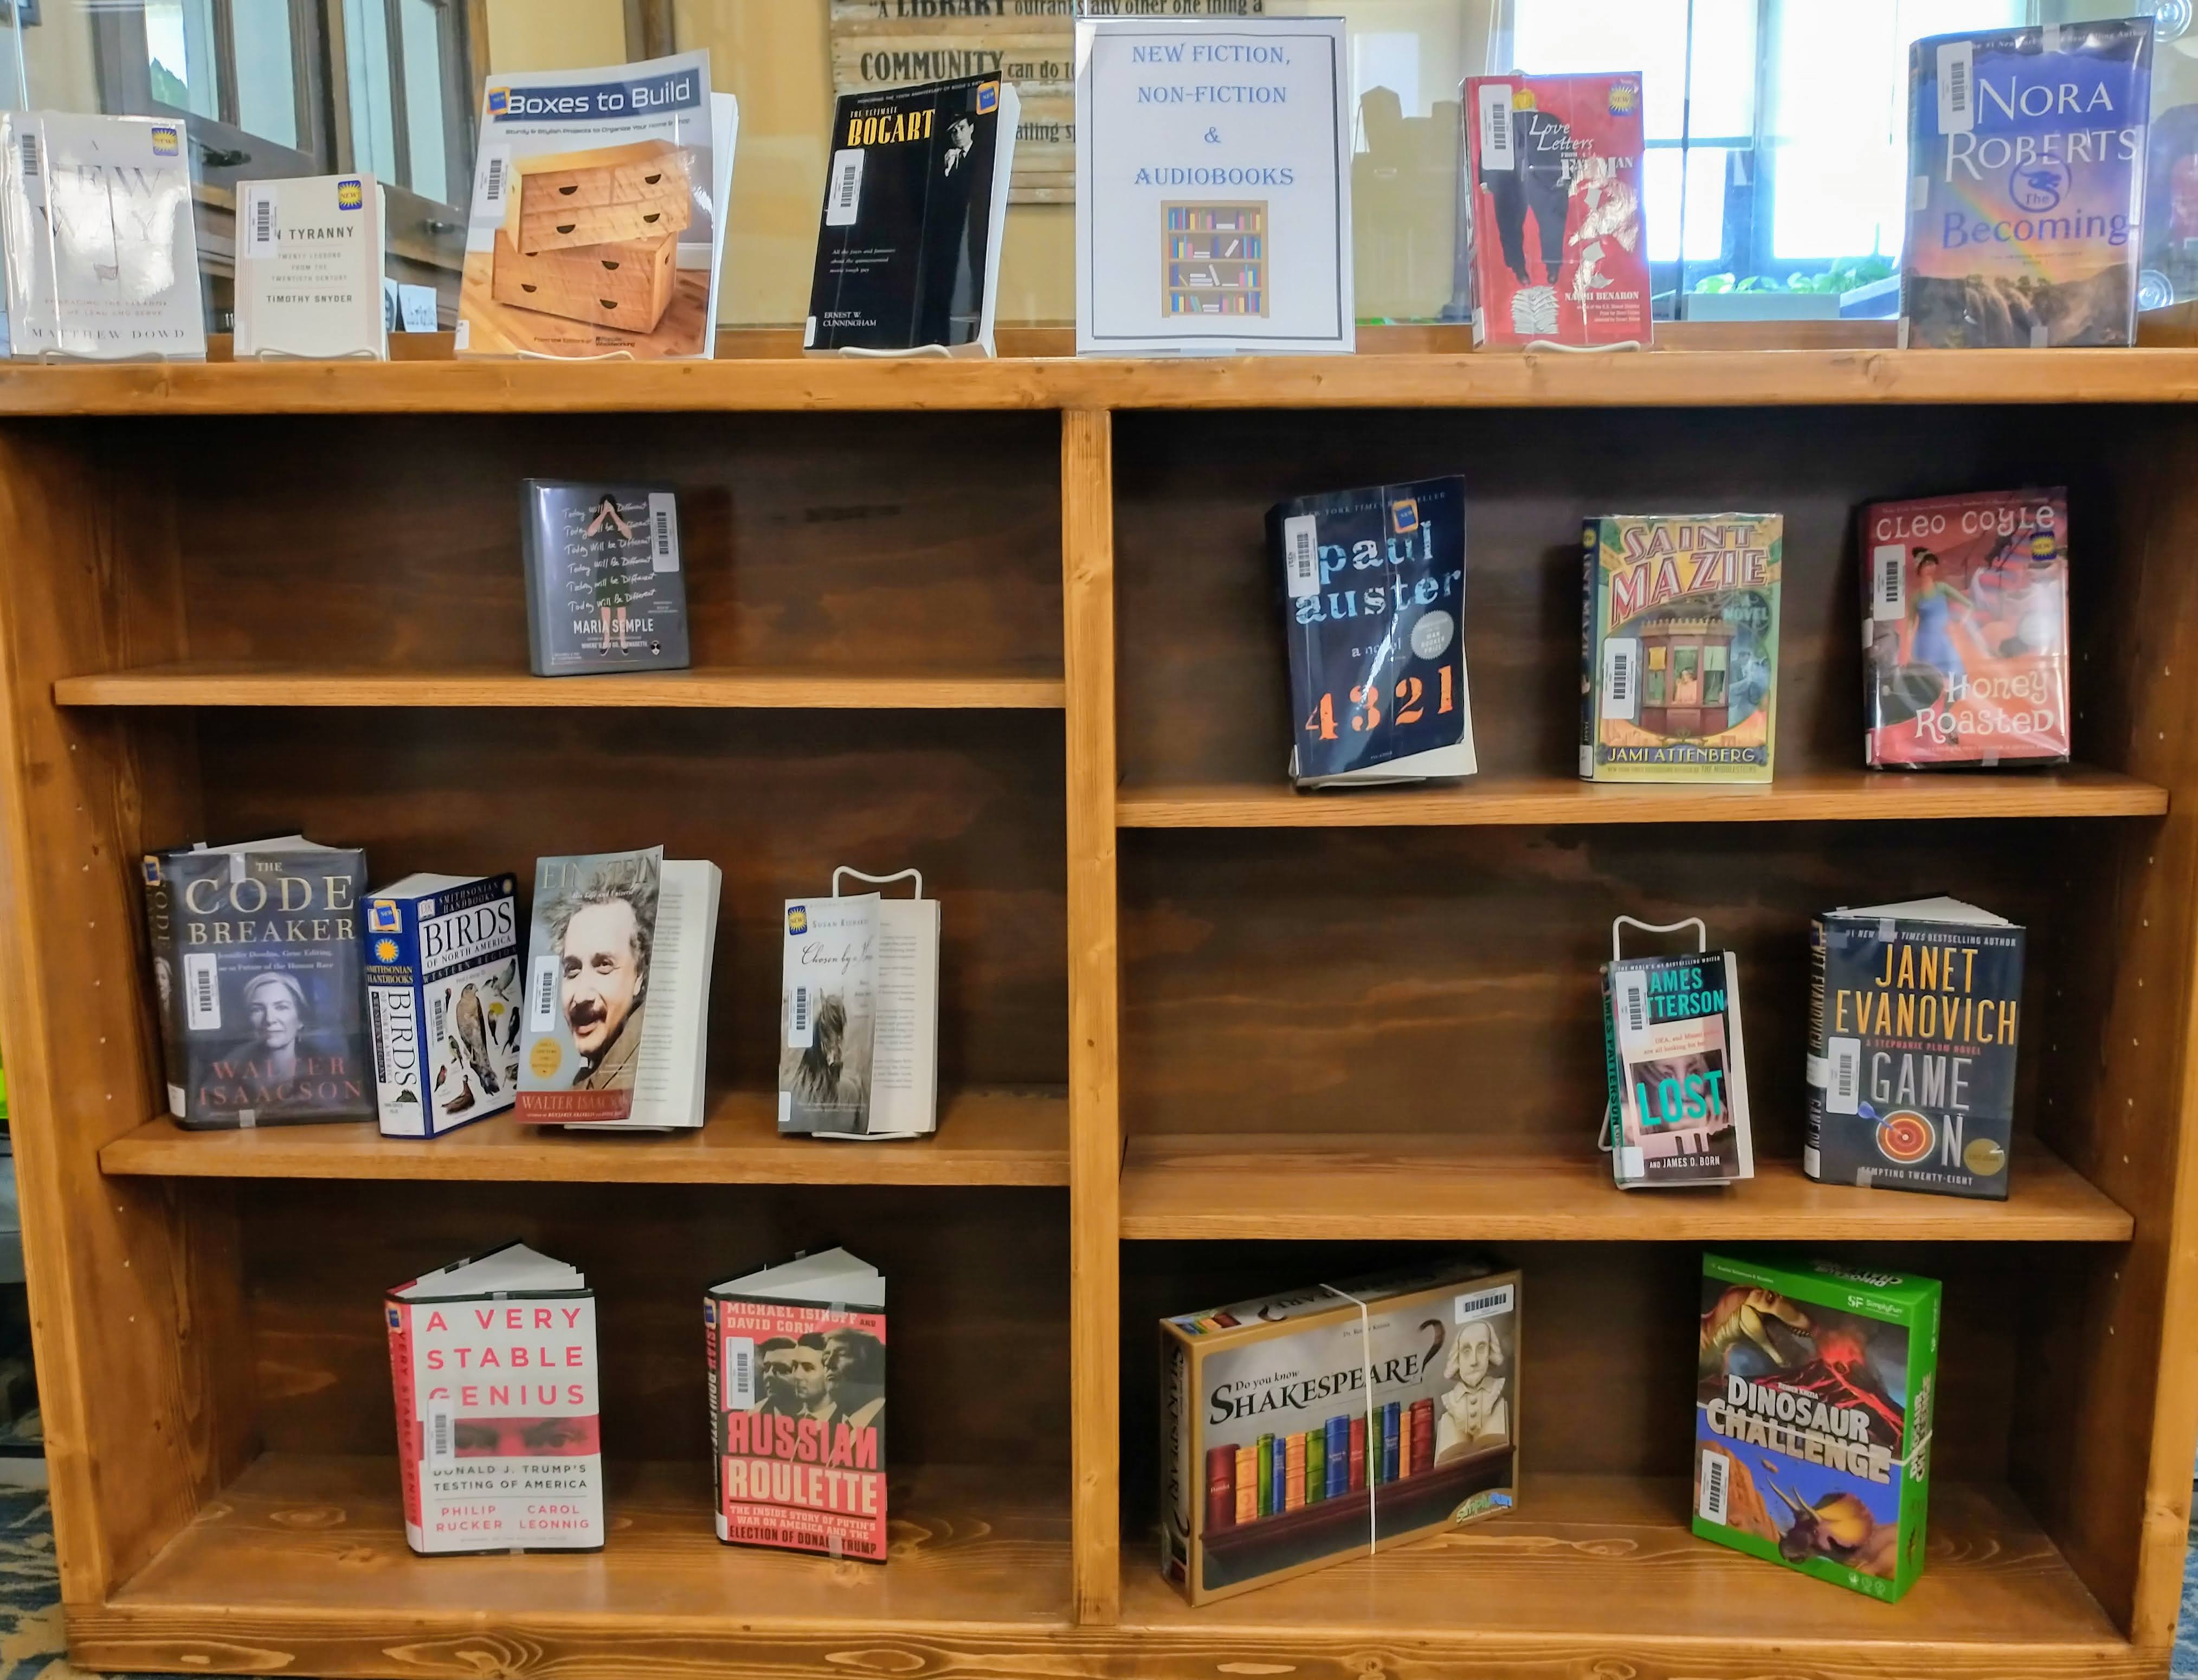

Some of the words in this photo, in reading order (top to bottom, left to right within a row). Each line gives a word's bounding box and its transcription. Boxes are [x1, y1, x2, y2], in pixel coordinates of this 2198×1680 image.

[897, 0, 1005, 17] LIBRARY
[1125, 0, 1165, 14] other
[1172, 0, 1202, 14] one
[1206, 0, 1246, 15] thing
[1253, 1, 1263, 14] a
[860, 50, 1005, 81] COMMUNITY
[1007, 61, 1034, 79] can
[1040, 60, 1059, 79] do
[1132, 42, 1185, 62] NEW
[1193, 44, 1291, 66] FICTION,
[507, 94, 590, 114] Boxes
[596, 92, 624, 111] to
[631, 77, 691, 108] Build
[1138, 86, 1286, 104] NON-FICTION
[1977, 76, 2114, 124] NORA
[601, 125, 631, 134] Organize
[847, 108, 936, 147] BOGART
[1204, 126, 1221, 144] &
[1529, 114, 1570, 136] Love
[1537, 133, 1595, 151] Letters
[1945, 128, 2137, 182] ROBERTS
[1134, 168, 1294, 185] AUDIOBOOKS
[2025, 193, 2050, 205] The
[288, 226, 354, 240] TYRANNY
[1942, 208, 2128, 249] Becoming
[314, 295, 352, 303] SNYDER
[1596, 291, 1640, 300] BENARON
[32, 328, 120, 339] MATTHEW
[132, 329, 185, 339] DOWD
[563, 525, 588, 539] Today
[564, 544, 588, 557] Today
[590, 542, 604, 552] Will
[1318, 520, 1433, 585] paul
[1623, 525, 1757, 565] SAINT
[568, 562, 591, 576] Today
[566, 580, 593, 595] Today
[620, 572, 656, 584] Different
[1610, 549, 1771, 628] MAZIE
[568, 600, 594, 613] Today
[625, 588, 657, 603] Different
[1295, 569, 1462, 625] auster
[1723, 607, 1768, 621] NOVEL
[573, 619, 609, 634] MARIA
[1351, 647, 1362, 658] a
[1944, 671, 2048, 704] Honey
[1304, 692, 1339, 740] 4
[1349, 684, 1381, 732] 3
[1395, 676, 1424, 726] 2
[1437, 664, 1454, 715] 1
[1607, 748, 1649, 762] JAMI
[1654, 748, 1756, 762] ATTENBERG
[255, 861, 282, 872] THE
[542, 853, 660, 890] EINSTEIN
[185, 874, 354, 915] CODE
[188, 918, 356, 945] BREAKER
[423, 902, 512, 958] BIRDS
[813, 920, 837, 929] SUSAN
[1857, 930, 1874, 938] NEW
[1900, 931, 1925, 942] TIMES
[1927, 932, 1981, 945] BESTSELLING
[1983, 936, 2017, 947] AUTHOR
[427, 960, 438, 969] OF
[441, 949, 471, 962] NORTH
[475, 935, 512, 954] AMERICA
[801, 941, 837, 965] Chosen
[841, 943, 852, 975] by
[1666, 959, 1700, 968] BESTSELLING
[366, 965, 412, 974] SMITHSONIAN
[367, 974, 414, 984] HANDBOOKS
[1874, 943, 1978, 994] JANET
[1649, 967, 1703, 994] AMES
[1835, 989, 2017, 1045] EVANOVICH
[388, 989, 417, 1086] BIRDS
[1926, 1042, 1950, 1053] PLUM
[212, 1056, 346, 1080] WALTER
[199, 1079, 364, 1106] ISAACSON
[1606, 1037, 1620, 1125] PATTERSON
[1870, 1051, 1973, 1111] GAME
[521, 1095, 573, 1110] WALTER
[1636, 1070, 1723, 1127] LOST
[1649, 1160, 1661, 1169] AND
[1662, 1157, 1687, 1169] JAMES
[1699, 1155, 1721, 1167] BORN
[1907, 1170, 1974, 1186] TWENTY-EIGHT
[1847, 1295, 1864, 1308] SF
[426, 1311, 448, 1332] A
[474, 1307, 582, 1330] VERY
[726, 1302, 795, 1319] MICHAEL
[800, 1308, 858, 1325] ISIKOFF
[726, 1316, 771, 1330] DAVID
[776, 1319, 815, 1334] CORN
[427, 1346, 584, 1370] STABLE
[1235, 1380, 1251, 1392] Do
[1251, 1378, 1271, 1390] you
[1273, 1369, 1300, 1383] know
[1728, 1374, 1871, 1445] DINOSAUR
[1706, 1397, 1892, 1485] CHALLENGE
[503, 1465, 515, 1474] J.
[521, 1464, 586, 1474] TRUMP'S
[433, 1481, 494, 1492] TESTING
[499, 1481, 518, 1489] OF
[524, 1479, 588, 1489] AMERICA
[727, 1458, 878, 1516] ROULETTE
[441, 1505, 497, 1516] PHILIP
[527, 1504, 579, 1514] CAROL
[729, 1505, 750, 1516] THE
[752, 1507, 787, 1519] INSIDE
[789, 1510, 820, 1523] STORY
[822, 1514, 834, 1525] OF
[836, 1517, 876, 1531] PUTIN'S
[435, 1520, 503, 1532] RUCKER
[519, 1519, 590, 1529] LEONNIG
[737, 1515, 761, 1525] WAR
[763, 1517, 777, 1527] ON
[779, 1520, 823, 1534] AMERICA
[826, 1525, 847, 1537] AND
[849, 1529, 870, 1540] THE
[730, 1525, 778, 1541] ELECTION
[782, 1530, 794, 1543] OF
[841, 1539, 877, 1555] TRUMP
